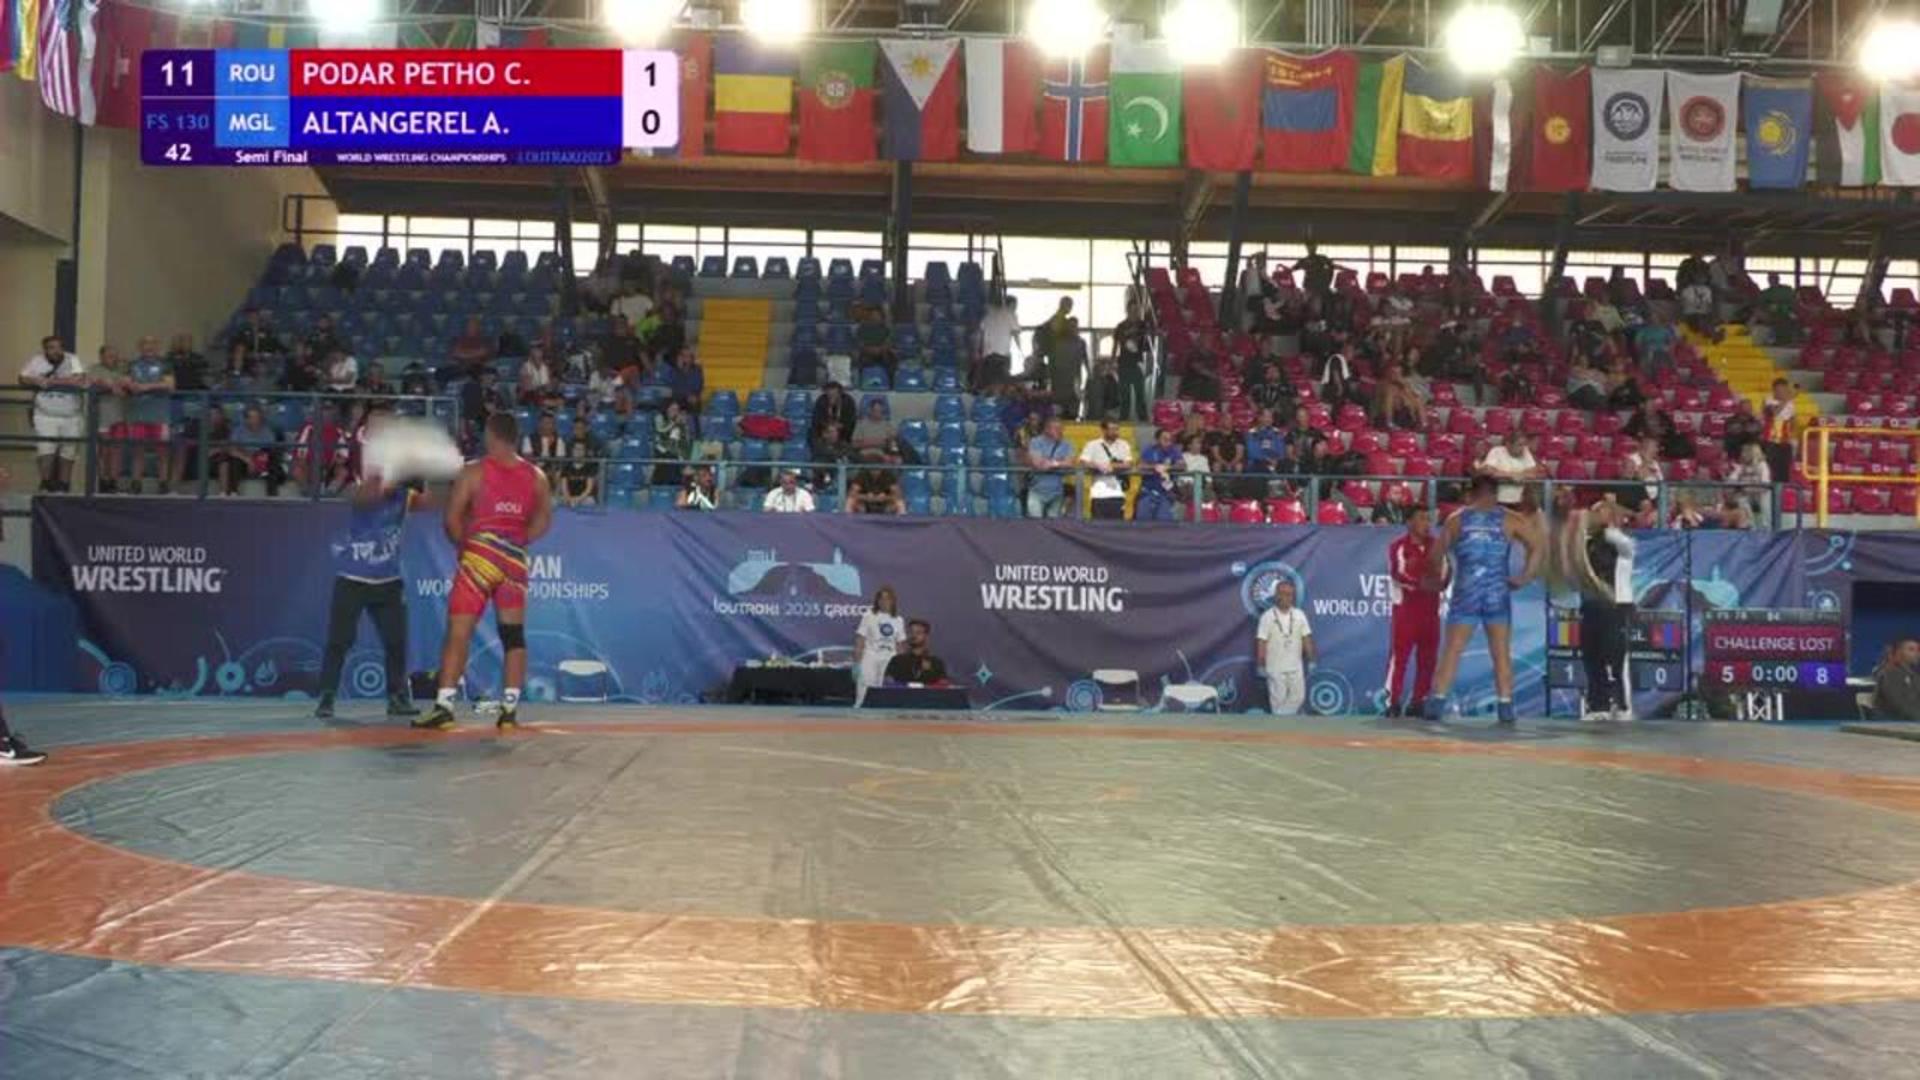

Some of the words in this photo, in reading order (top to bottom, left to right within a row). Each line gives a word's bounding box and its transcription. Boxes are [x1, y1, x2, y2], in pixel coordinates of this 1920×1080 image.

[88, 545, 145, 563] UNITED
[149, 546, 206, 564] WORLD
[72, 565, 222, 593] WRESTLING
[995, 564, 1049, 581] UNITED
[1053, 565, 1108, 583] WORLD
[981, 583, 1123, 612] WRESTLING
[1313, 599, 1369, 616] WORLD
[1714, 636, 1796, 650] CHALLENGE
[1800, 637, 1834, 650] LOST
[1721, 665, 1734, 682] 5
[1752, 665, 1798, 682] 0:00
[1816, 667, 1829, 684] 8
